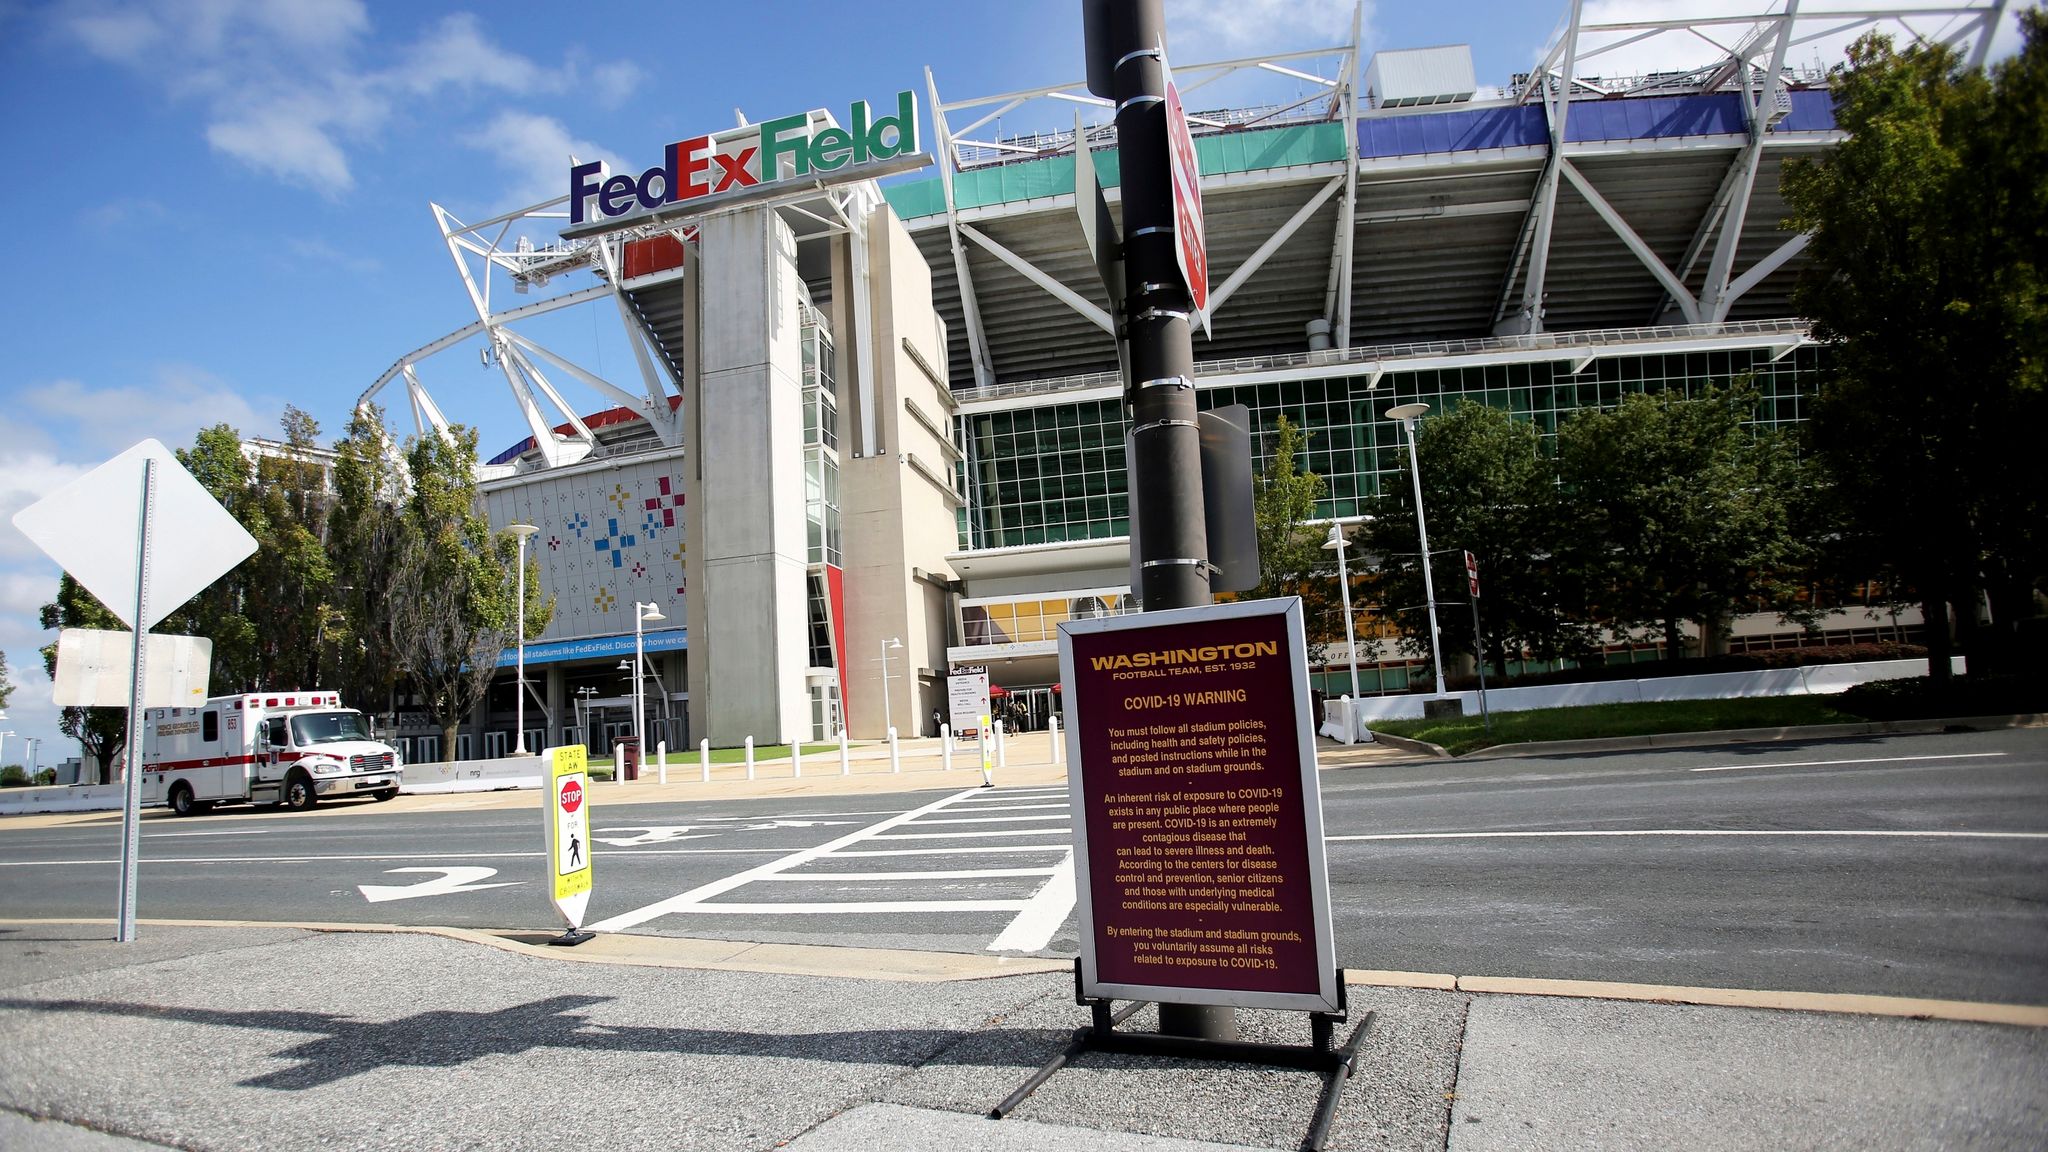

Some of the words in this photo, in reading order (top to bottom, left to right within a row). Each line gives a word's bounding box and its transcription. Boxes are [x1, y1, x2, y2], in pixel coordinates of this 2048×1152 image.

[570, 90, 920, 225] FedExField
[532, 649, 562, 659] stadiums
[562, 647, 574, 655] like
[575, 643, 614, 654] FedExField.
[648, 638, 664, 646] how
[665, 637, 677, 645] we
[1090, 641, 1277, 670] WASHINGTON
[1331, 651, 1368, 660] OFFCE
[1112, 669, 1166, 680] FOOTBALL
[1167, 666, 1201, 675] TEAM,
[1204, 663, 1226, 672] EST.
[1229, 661, 1255, 670] 1932
[1124, 694, 1180, 709] COVID-19
[1183, 688, 1246, 705] WARNING
[227, 718, 237, 730] 853
[1108, 728, 1124, 737] You
[1126, 726, 1147, 736] must
[1149, 725, 1175, 734] follow
[1178, 723, 1188, 733] all
[1190, 721, 1225, 732] stadium
[1228, 719, 1266, 732] policies,
[1110, 739, 1149, 750] including
[1151, 737, 1177, 747] health
[1180, 736, 1196, 746] and
[1198, 735, 1225, 746] safety
[1227, 733, 1265, 746] policies,
[560, 749, 580, 761] STATE
[1112, 753, 1127, 763] and
[1129, 751, 1158, 764] posted
[1160, 750, 1213, 760] instructions
[1214, 748, 1238, 758] while
[1240, 747, 1249, 756] in
[1251, 746, 1266, 756] the
[469, 769, 481, 778] nrg
[563, 762, 578, 772] LAW
[1118, 766, 1152, 776] stadium
[1154, 765, 1170, 774] and
[1186, 762, 1221, 773] stadium
[1223, 760, 1264, 773] grounds.
[561, 791, 582, 804] STOP
[1104, 794, 1115, 802] An
[1117, 792, 1152, 802] inherent
[1154, 792, 1170, 801] risk
[1172, 791, 1181, 800] of
[1183, 791, 1224, 802] exposure
[1226, 790, 1236, 799] to
[1238, 787, 1282, 798] COVID-19
[1108, 806, 1133, 816] exists
[1135, 806, 1143, 815] in
[1145, 807, 1161, 817] any
[1163, 804, 1190, 816] public
[1192, 804, 1216, 816] place
[1218, 803, 1245, 812] where
[1247, 802, 1279, 814] people
[1112, 821, 1125, 829] are
[1128, 819, 1162, 830] present.
[1164, 817, 1206, 828] COVID-19
[1208, 817, 1216, 827] is
[1218, 819, 1229, 827] an
[1232, 816, 1276, 828] extremely
[1142, 832, 1190, 844] contagious
[1192, 831, 1226, 841] disease
[1228, 831, 1246, 840] that
[1133, 846, 1151, 855] lead
[1153, 846, 1162, 855] to
[1164, 847, 1193, 855] severe
[1195, 845, 1224, 854] illness
[1226, 844, 1243, 854] and
[1245, 844, 1274, 854] death.
[1119, 859, 1162, 871] According
[1164, 860, 1172, 868] to
[1174, 859, 1189, 868] the
[1191, 860, 1224, 868] centers
[1226, 859, 1239, 868] for
[1241, 858, 1276, 868] disease
[1115, 873, 1144, 882] control
[1146, 872, 1162, 882] and
[1165, 873, 1214, 884] prevention,
[1216, 873, 1245, 882] senior
[1247, 872, 1283, 882] citizens
[1124, 886, 1140, 895] and
[1142, 886, 1166, 896] those
[1168, 886, 1186, 896] with
[1188, 886, 1236, 899] underlying
[1238, 887, 1274, 897] medical
[1122, 899, 1166, 909] conditions
[1184, 900, 1228, 913] especially
[1231, 901, 1282, 911] vulnerable.
[1107, 925, 1118, 937] By
[1119, 926, 1152, 938] entering
[1154, 927, 1168, 936] the
[1169, 927, 1203, 937] stadium
[1205, 928, 1221, 938] and
[1223, 929, 1258, 939] stadium
[1260, 930, 1301, 942] grounds,
[1133, 942, 1149, 951] you
[1151, 941, 1197, 954] voluntarily
[1199, 944, 1234, 953] assume
[1236, 943, 1247, 953] all
[1250, 944, 1273, 954] risks
[1133, 953, 1162, 964] related
[1164, 955, 1173, 964] to
[1175, 957, 1216, 967] exposure
[1219, 957, 1228, 967] to
[1230, 957, 1277, 968] COVID-19.
